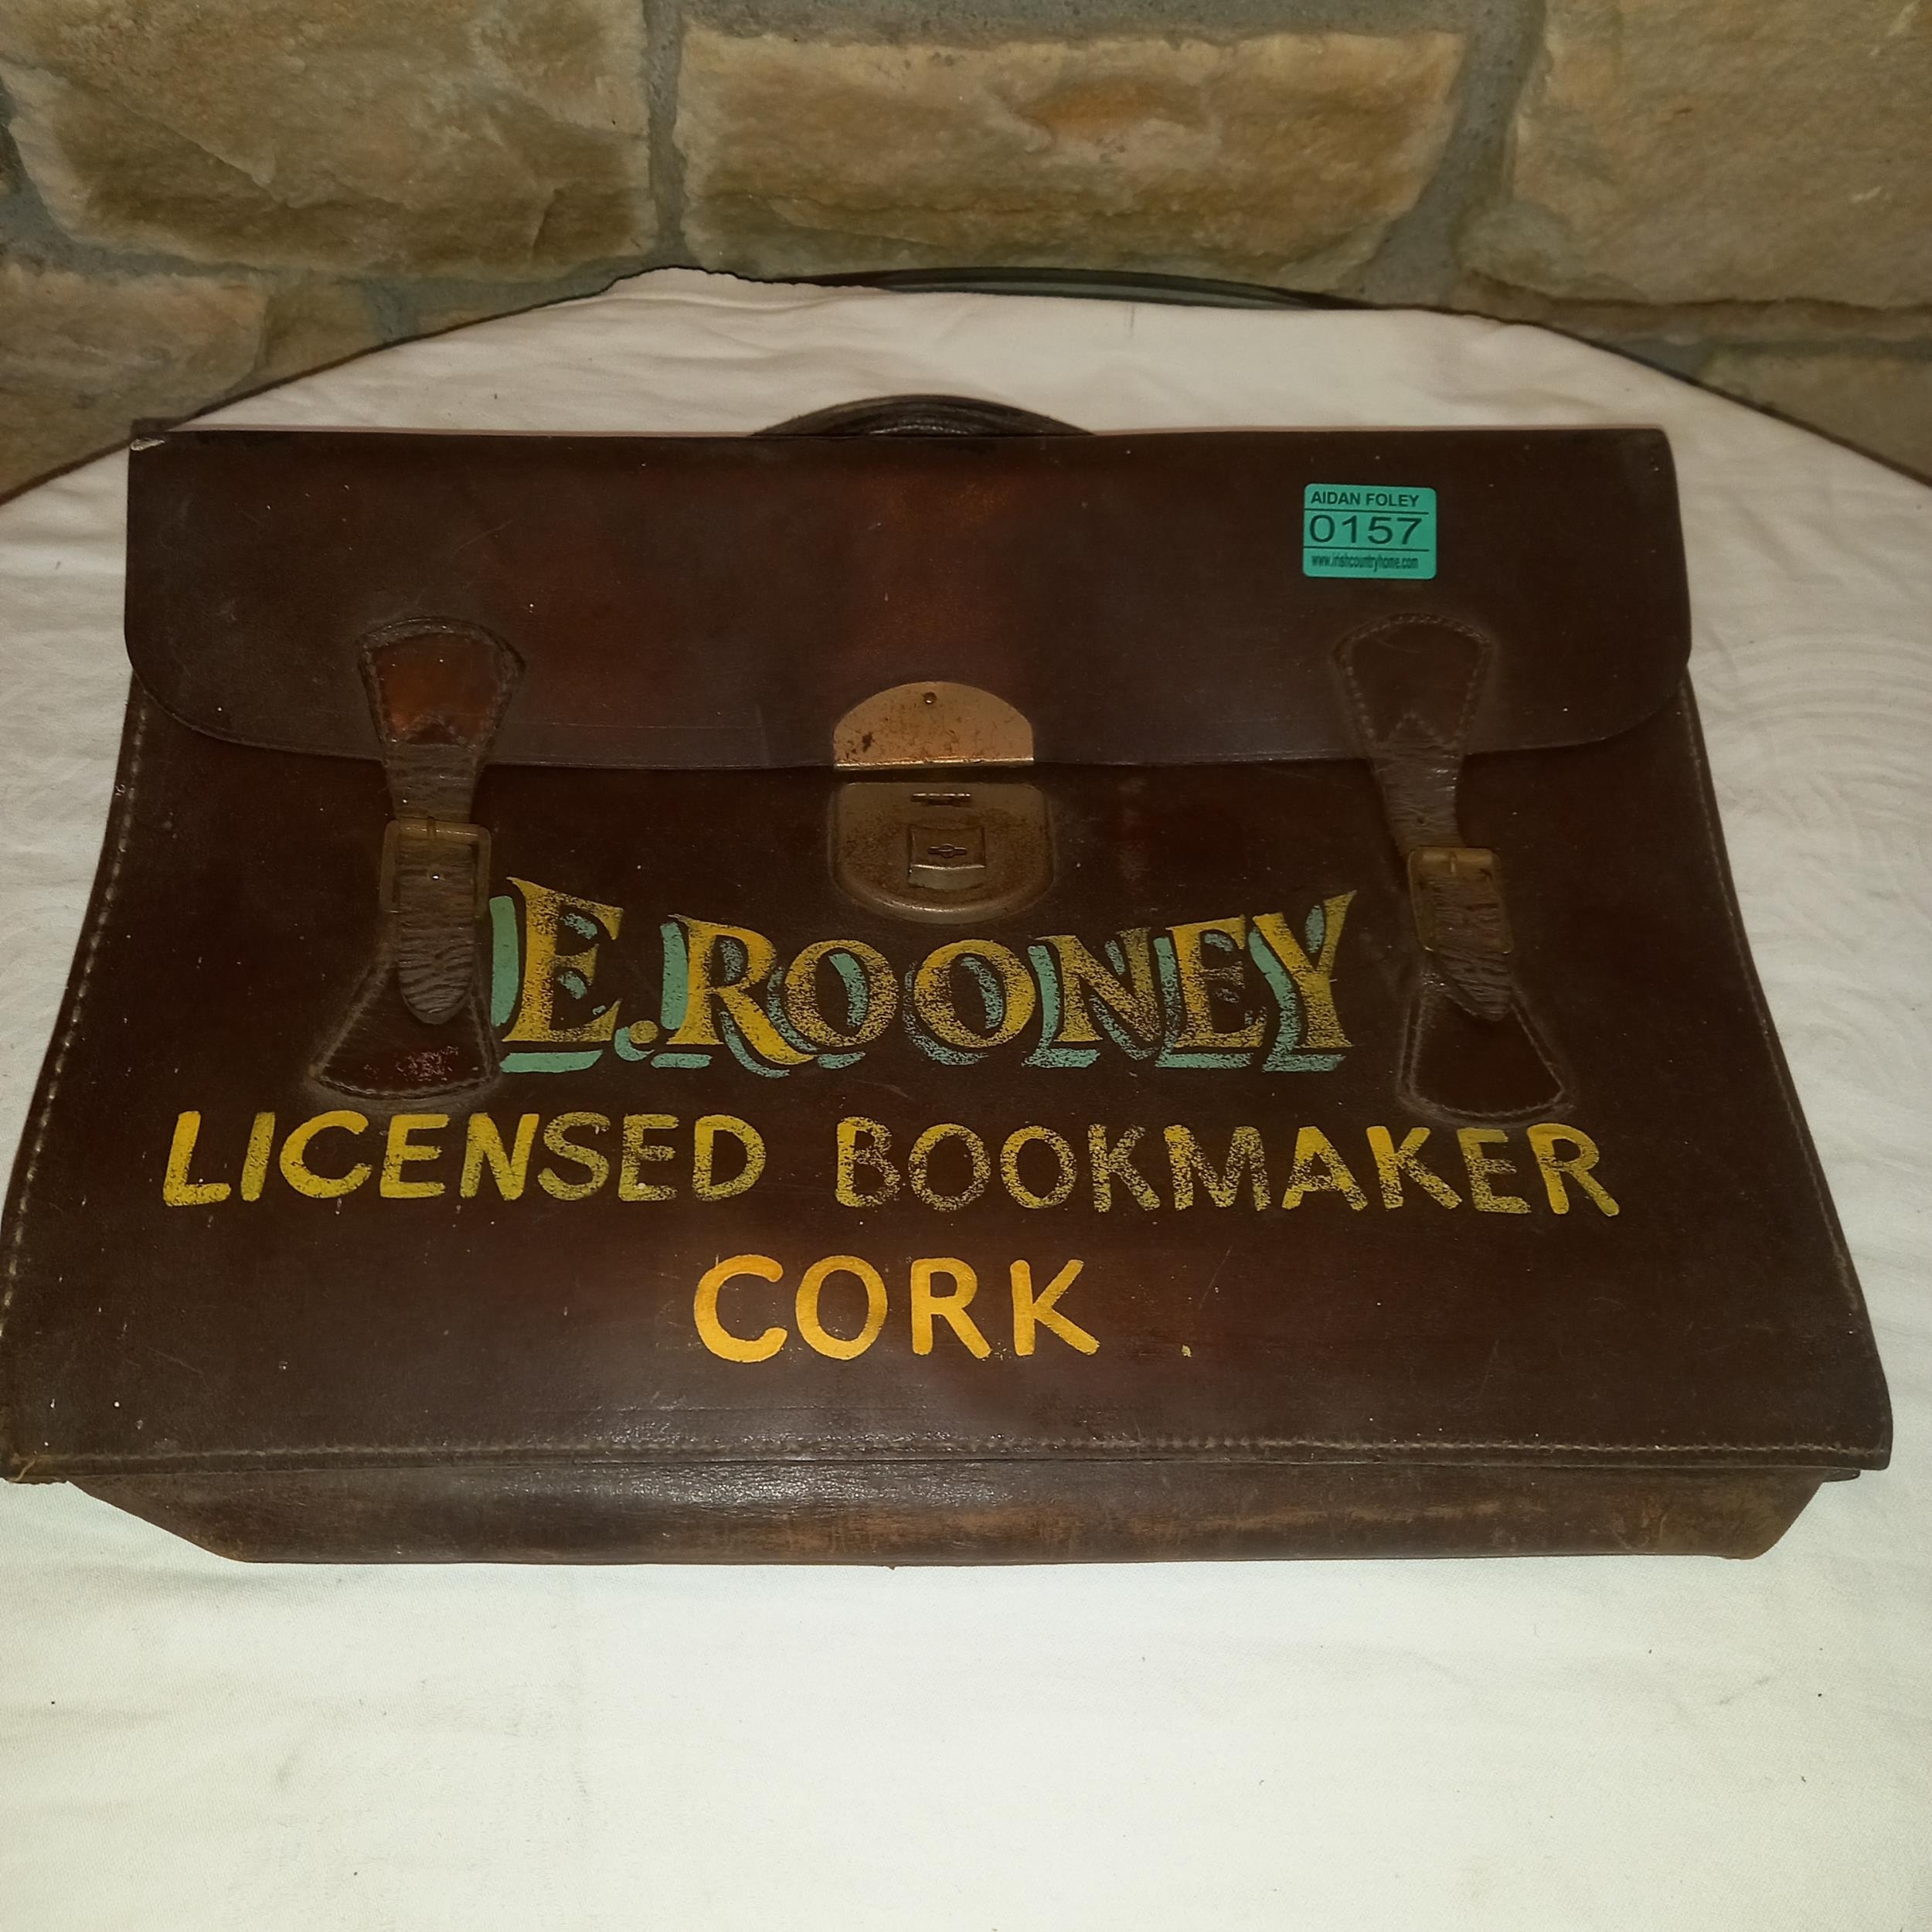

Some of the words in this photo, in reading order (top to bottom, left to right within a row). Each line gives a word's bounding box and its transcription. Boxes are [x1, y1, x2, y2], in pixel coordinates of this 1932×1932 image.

[1311, 491, 1360, 505] AIDAN
[1366, 493, 1420, 507] FOLEY
[1310, 515, 1423, 545] 0157
[1311, 553, 1419, 572] www.irishcountryhome.com
[163, 1111, 767, 1206] LICENSED
[835, 1116, 1620, 1217] BOOKMAKER
[694, 1253, 1100, 1363] CORK
